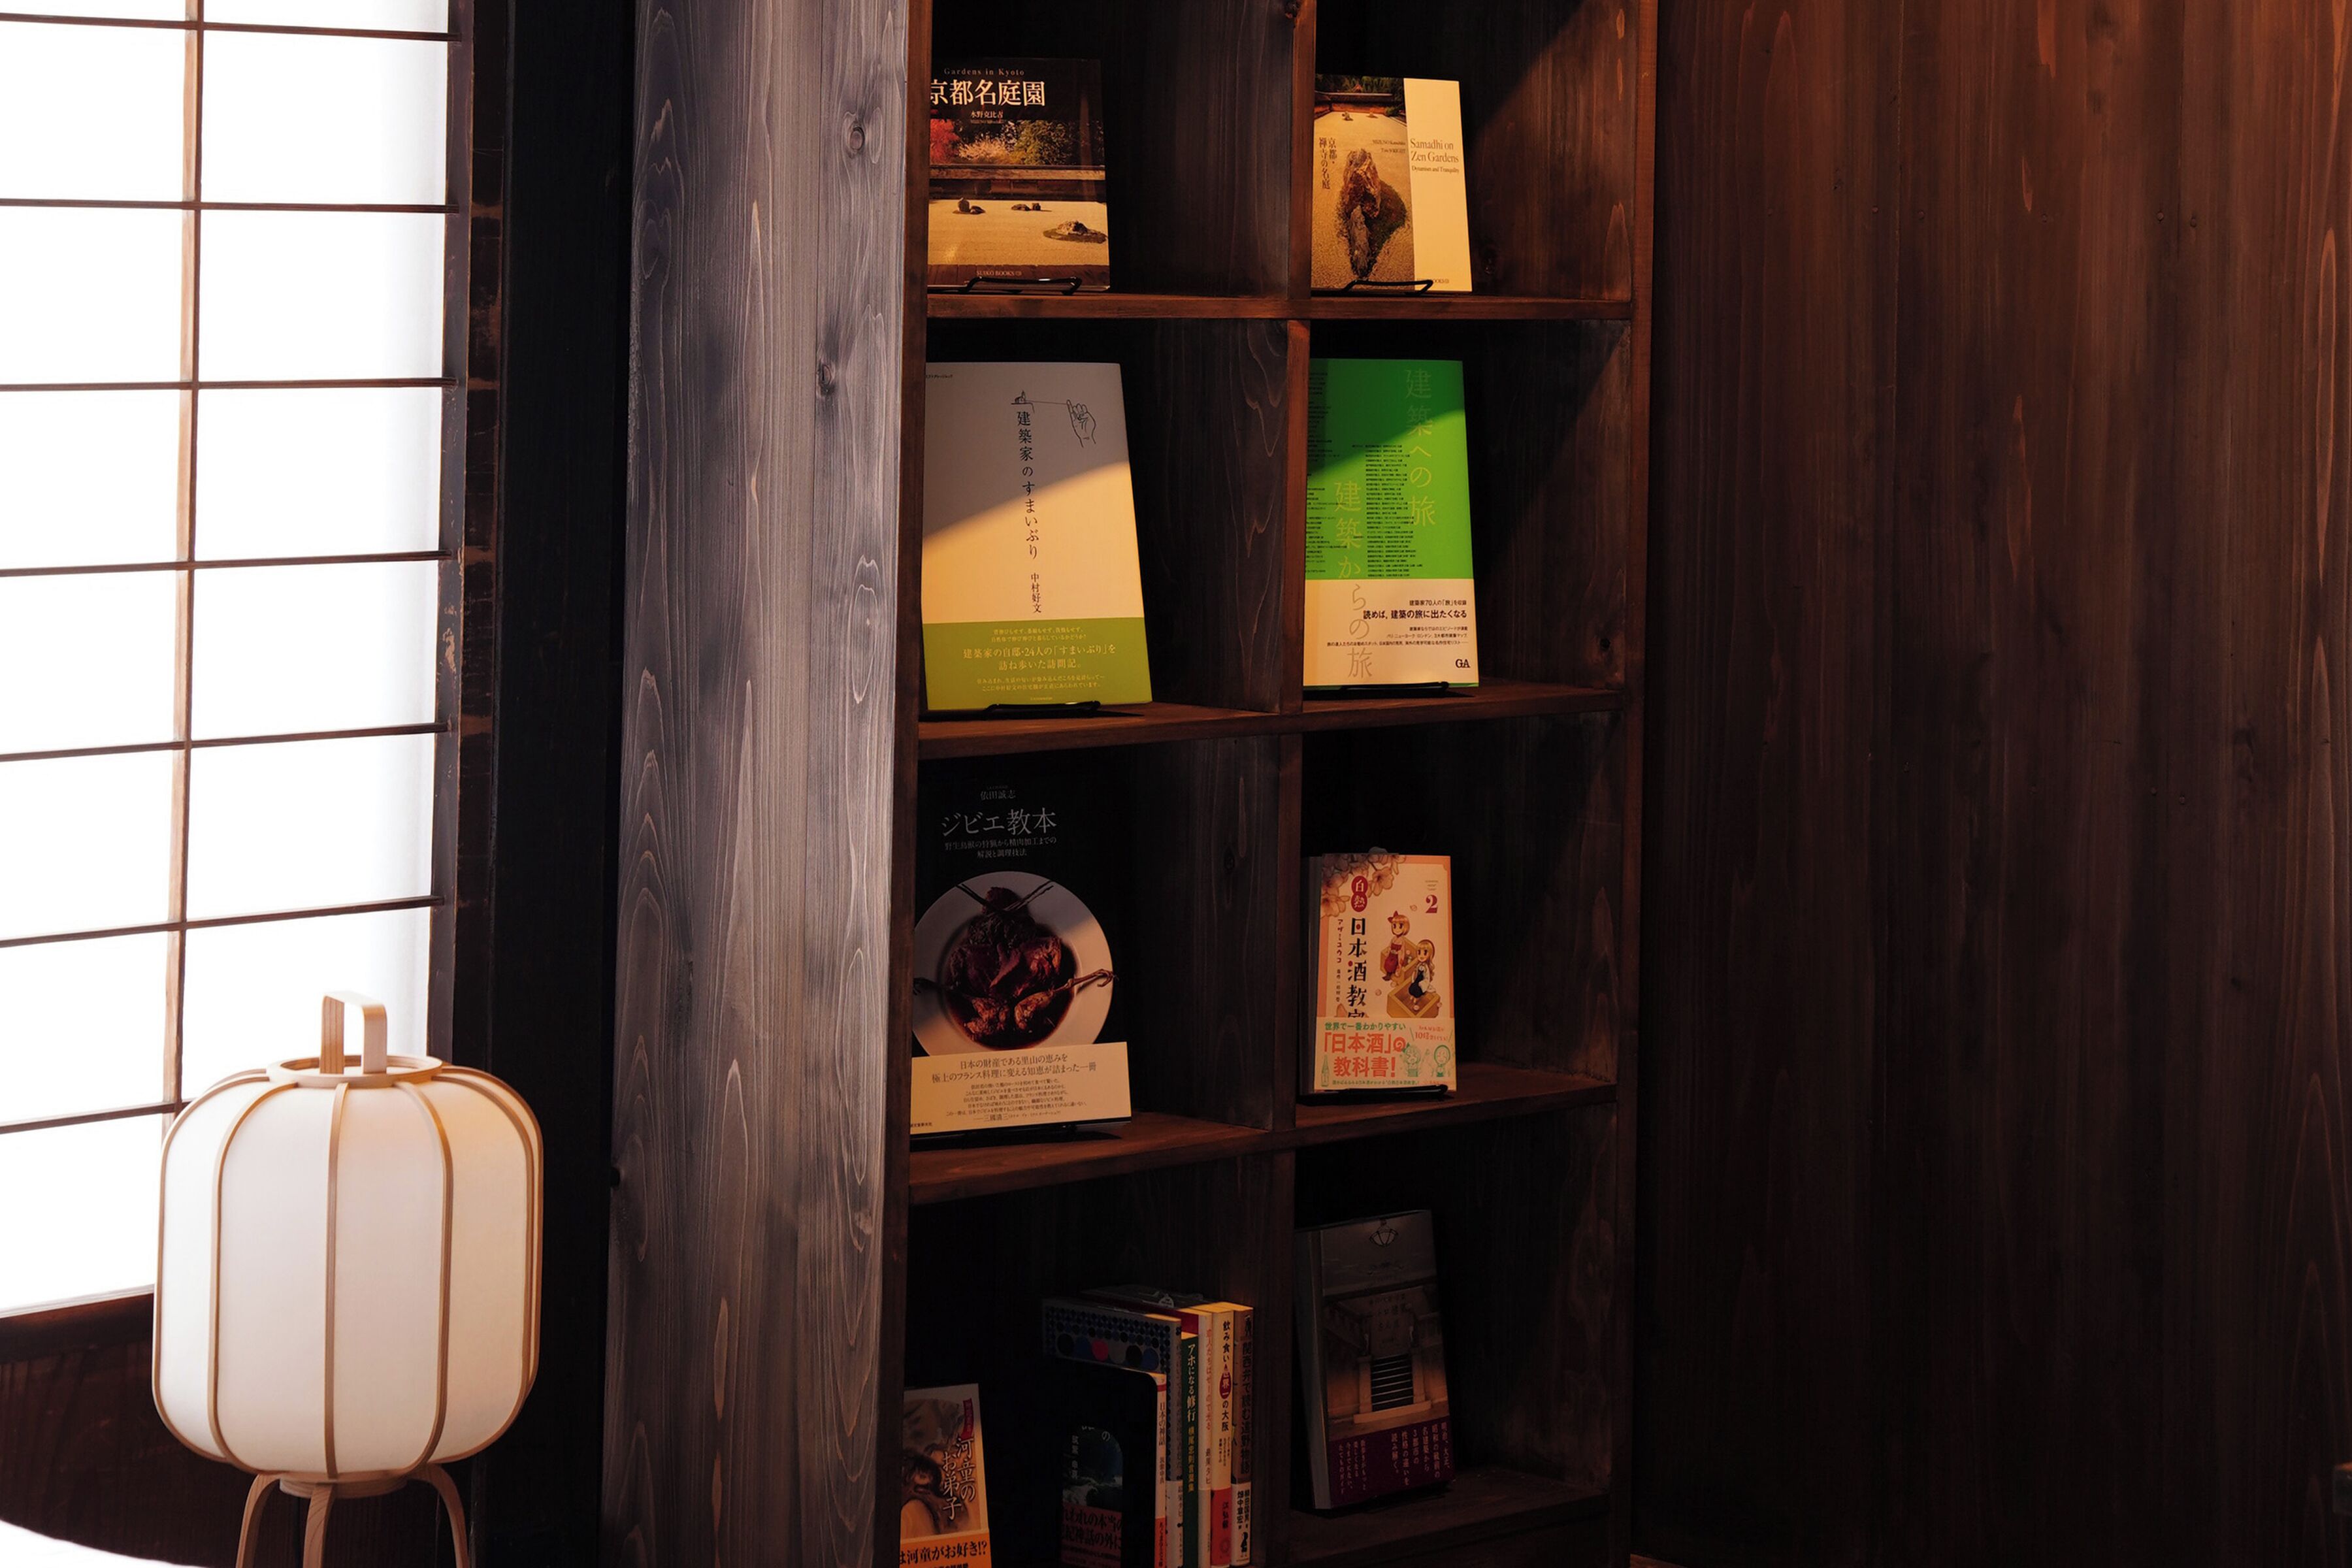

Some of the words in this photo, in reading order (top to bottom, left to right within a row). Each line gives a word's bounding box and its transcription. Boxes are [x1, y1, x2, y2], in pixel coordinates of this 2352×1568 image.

[998, 68, 1025, 77] Kyoto
[930, 79, 1045, 106] 京都名庭園
[1410, 138, 1443, 150] Samadhi
[1411, 151, 1426, 161] Zen
[1428, 152, 1459, 163] Gardens
[1405, 368, 1436, 527] 建築への旅
[1017, 411, 1039, 560] 建築家のすまいぶり
[1030, 572, 1042, 613] 中村好文
[1455, 659, 1471, 668] GA
[941, 807, 1058, 837] ジビエ教本
[1425, 894, 1437, 913] 2
[1324, 1021, 1406, 1031] 世界で一番わかりやすい
[1324, 1032, 1406, 1054] 「日本酒」の
[960, 1053, 1068, 1070] 日本の財産である里山の恵みを
[1333, 1056, 1396, 1077] 教科書!
[1186, 1343, 1196, 1422] アホになる修行
[1221, 1320, 1232, 1432] 飲み食い世界一の大阪
[956, 1437, 976, 1501] 河童の
[943, 1452, 962, 1521] お弟子
